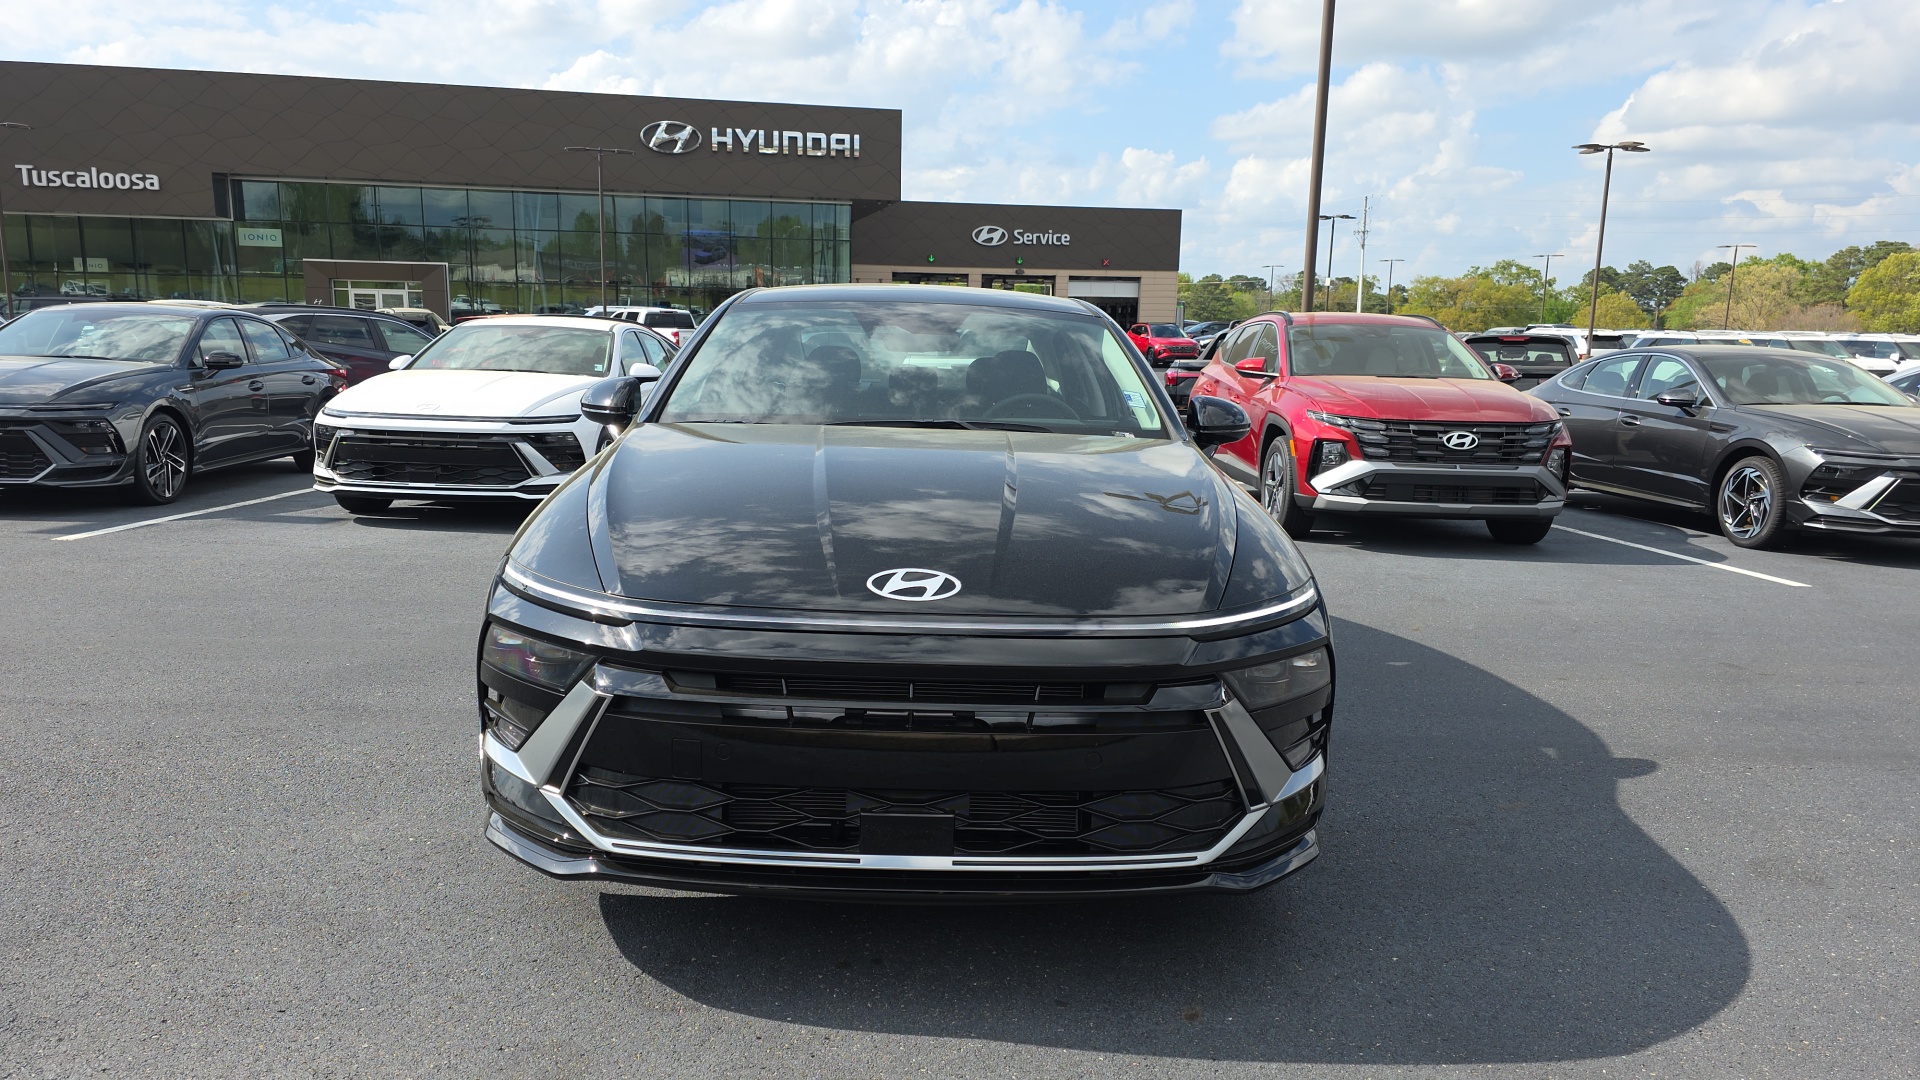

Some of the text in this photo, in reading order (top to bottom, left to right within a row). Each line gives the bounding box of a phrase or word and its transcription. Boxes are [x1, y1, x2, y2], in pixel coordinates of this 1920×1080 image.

[711, 127, 861, 158] HYUNDAI
[15, 164, 161, 191] Tuscaloosa
[243, 233, 277, 242] IONIQ
[1012, 228, 1071, 246] Service
